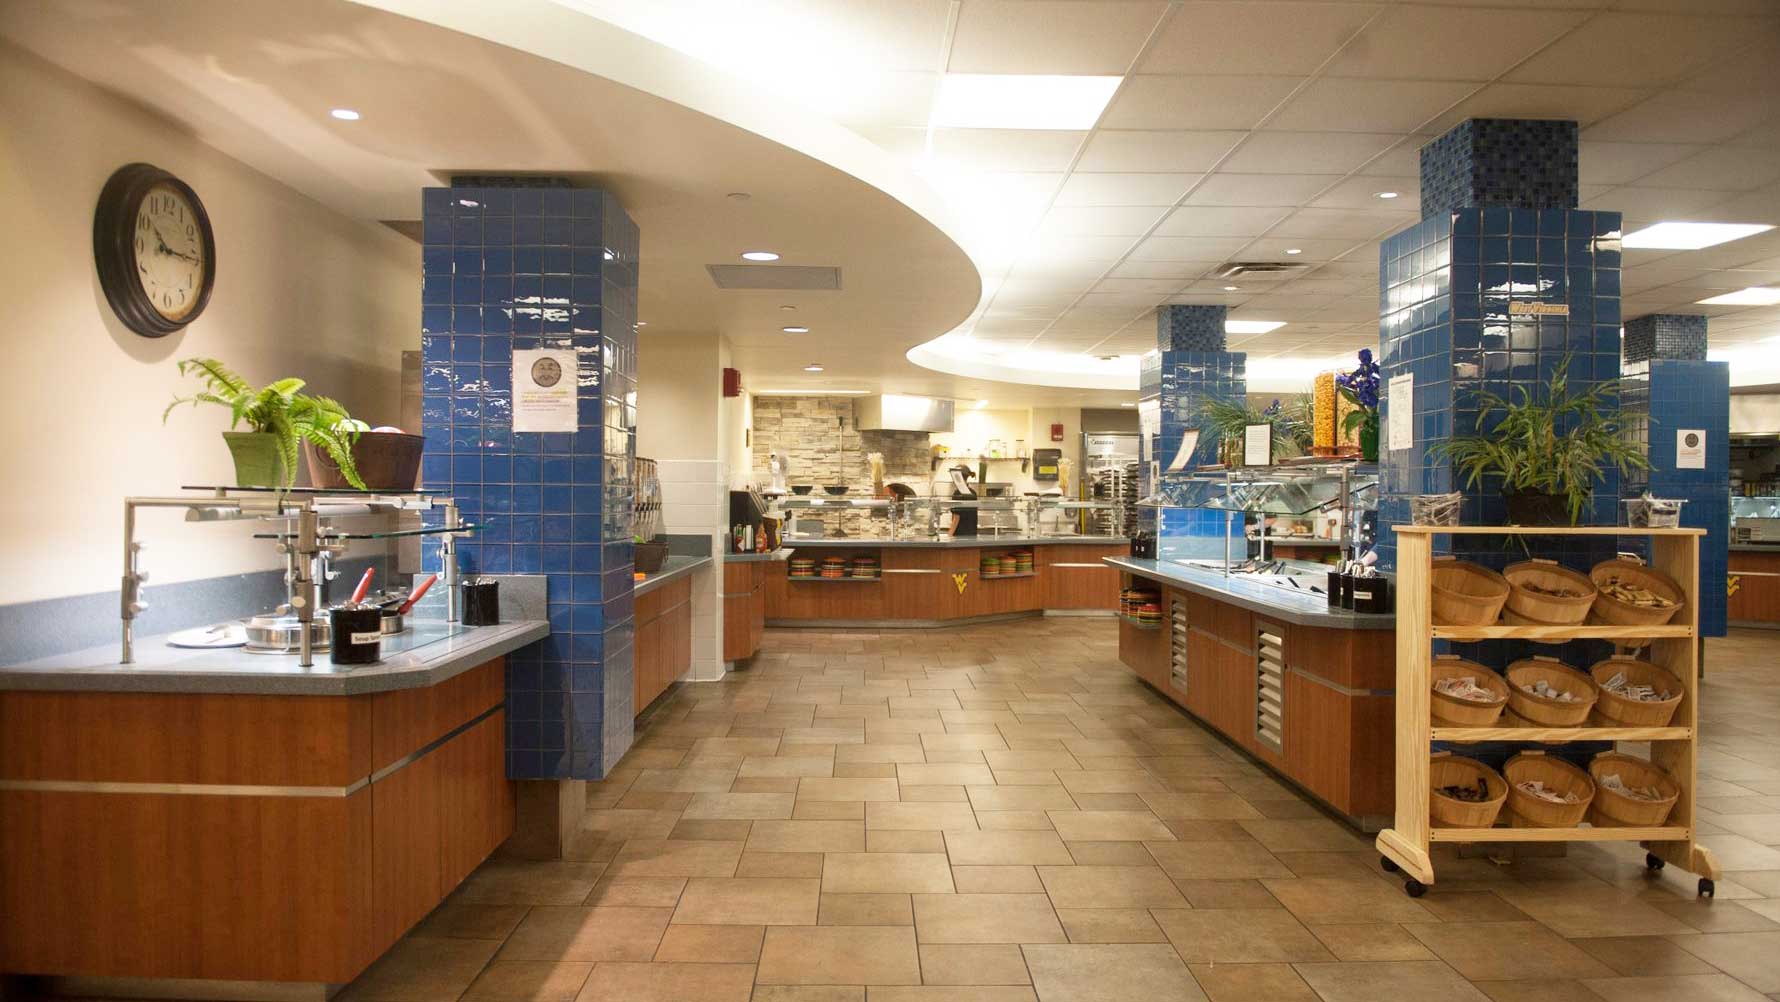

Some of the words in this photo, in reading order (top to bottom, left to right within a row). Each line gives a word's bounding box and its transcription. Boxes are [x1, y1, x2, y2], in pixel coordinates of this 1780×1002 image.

[150, 196, 159, 215] 11
[163, 194, 176, 216] 12
[138, 212, 151, 232] 10
[185, 224, 195, 243] 2
